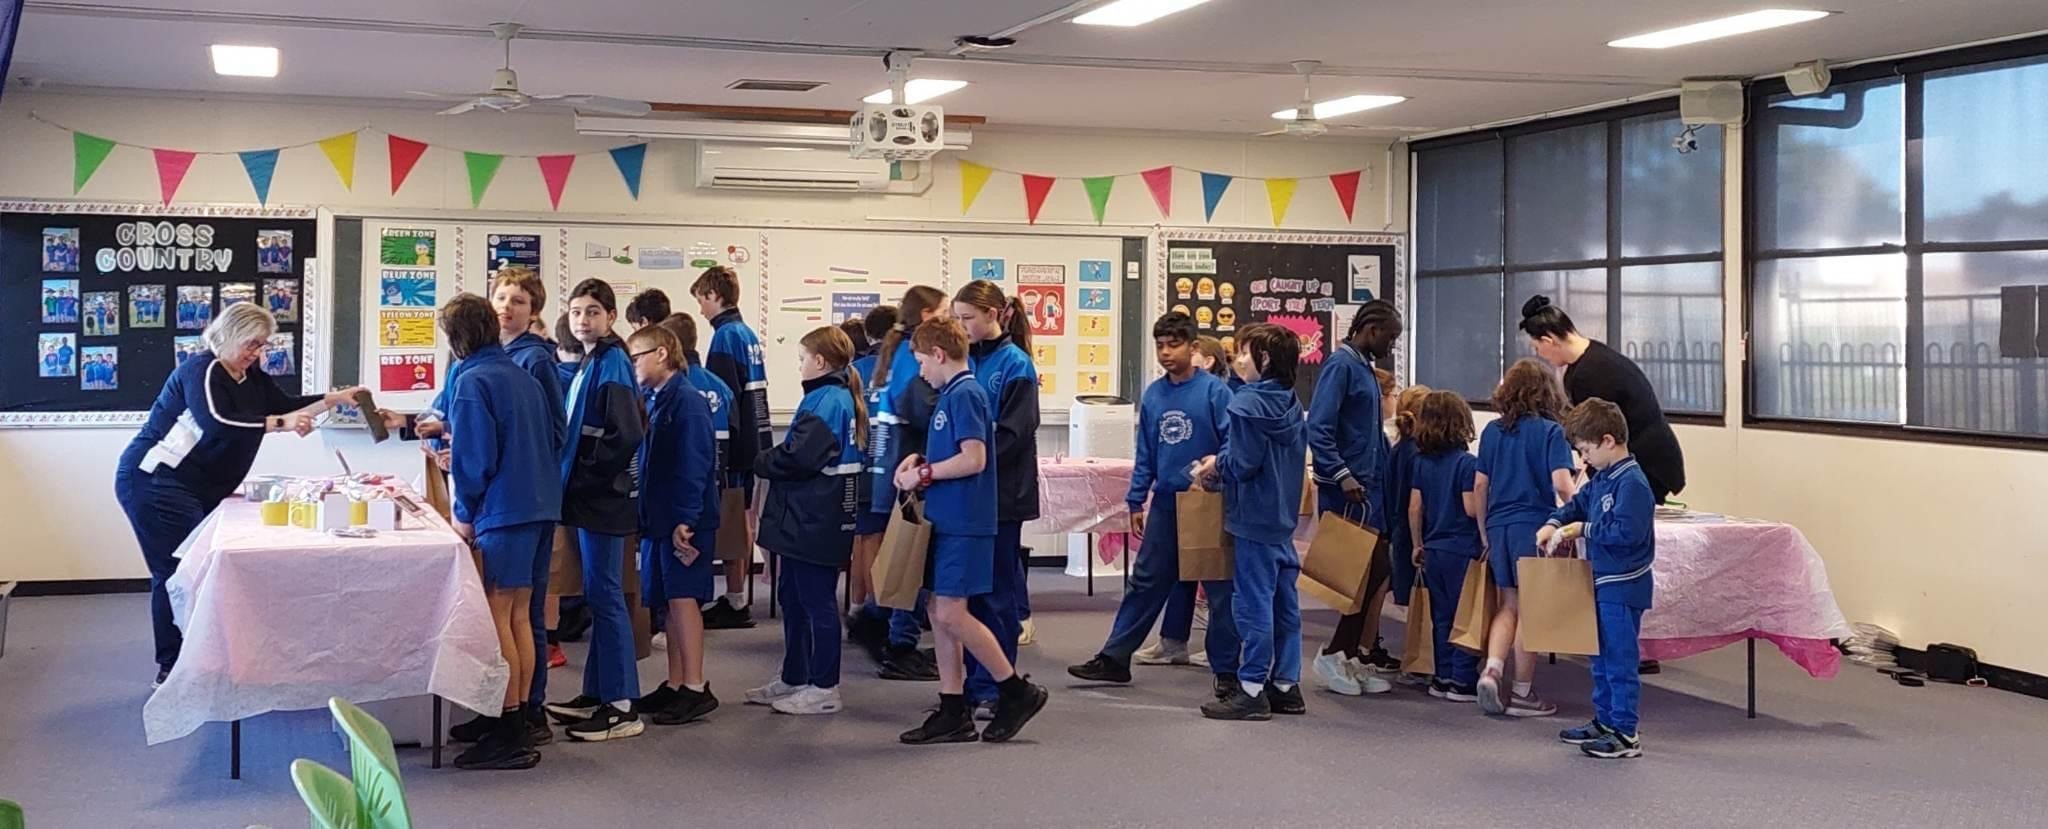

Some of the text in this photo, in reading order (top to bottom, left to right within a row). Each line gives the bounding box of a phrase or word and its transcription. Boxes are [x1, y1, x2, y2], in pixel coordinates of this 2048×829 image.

[115, 221, 215, 247] CROSS
[382, 229, 435, 238] GREEN ZONE
[490, 247, 497, 260] 1
[95, 247, 233, 273] COUNTRY
[498, 258, 509, 270] 2
[382, 270, 435, 280] BLUE ZONE
[1270, 278, 1304, 293] CAUGHT
[1306, 278, 1320, 293] UP
[1250, 297, 1281, 312] SPORT
[1311, 298, 1335, 312] TERM
[381, 311, 434, 319] YELLOW ZONE
[381, 354, 433, 366] RED ZONE
